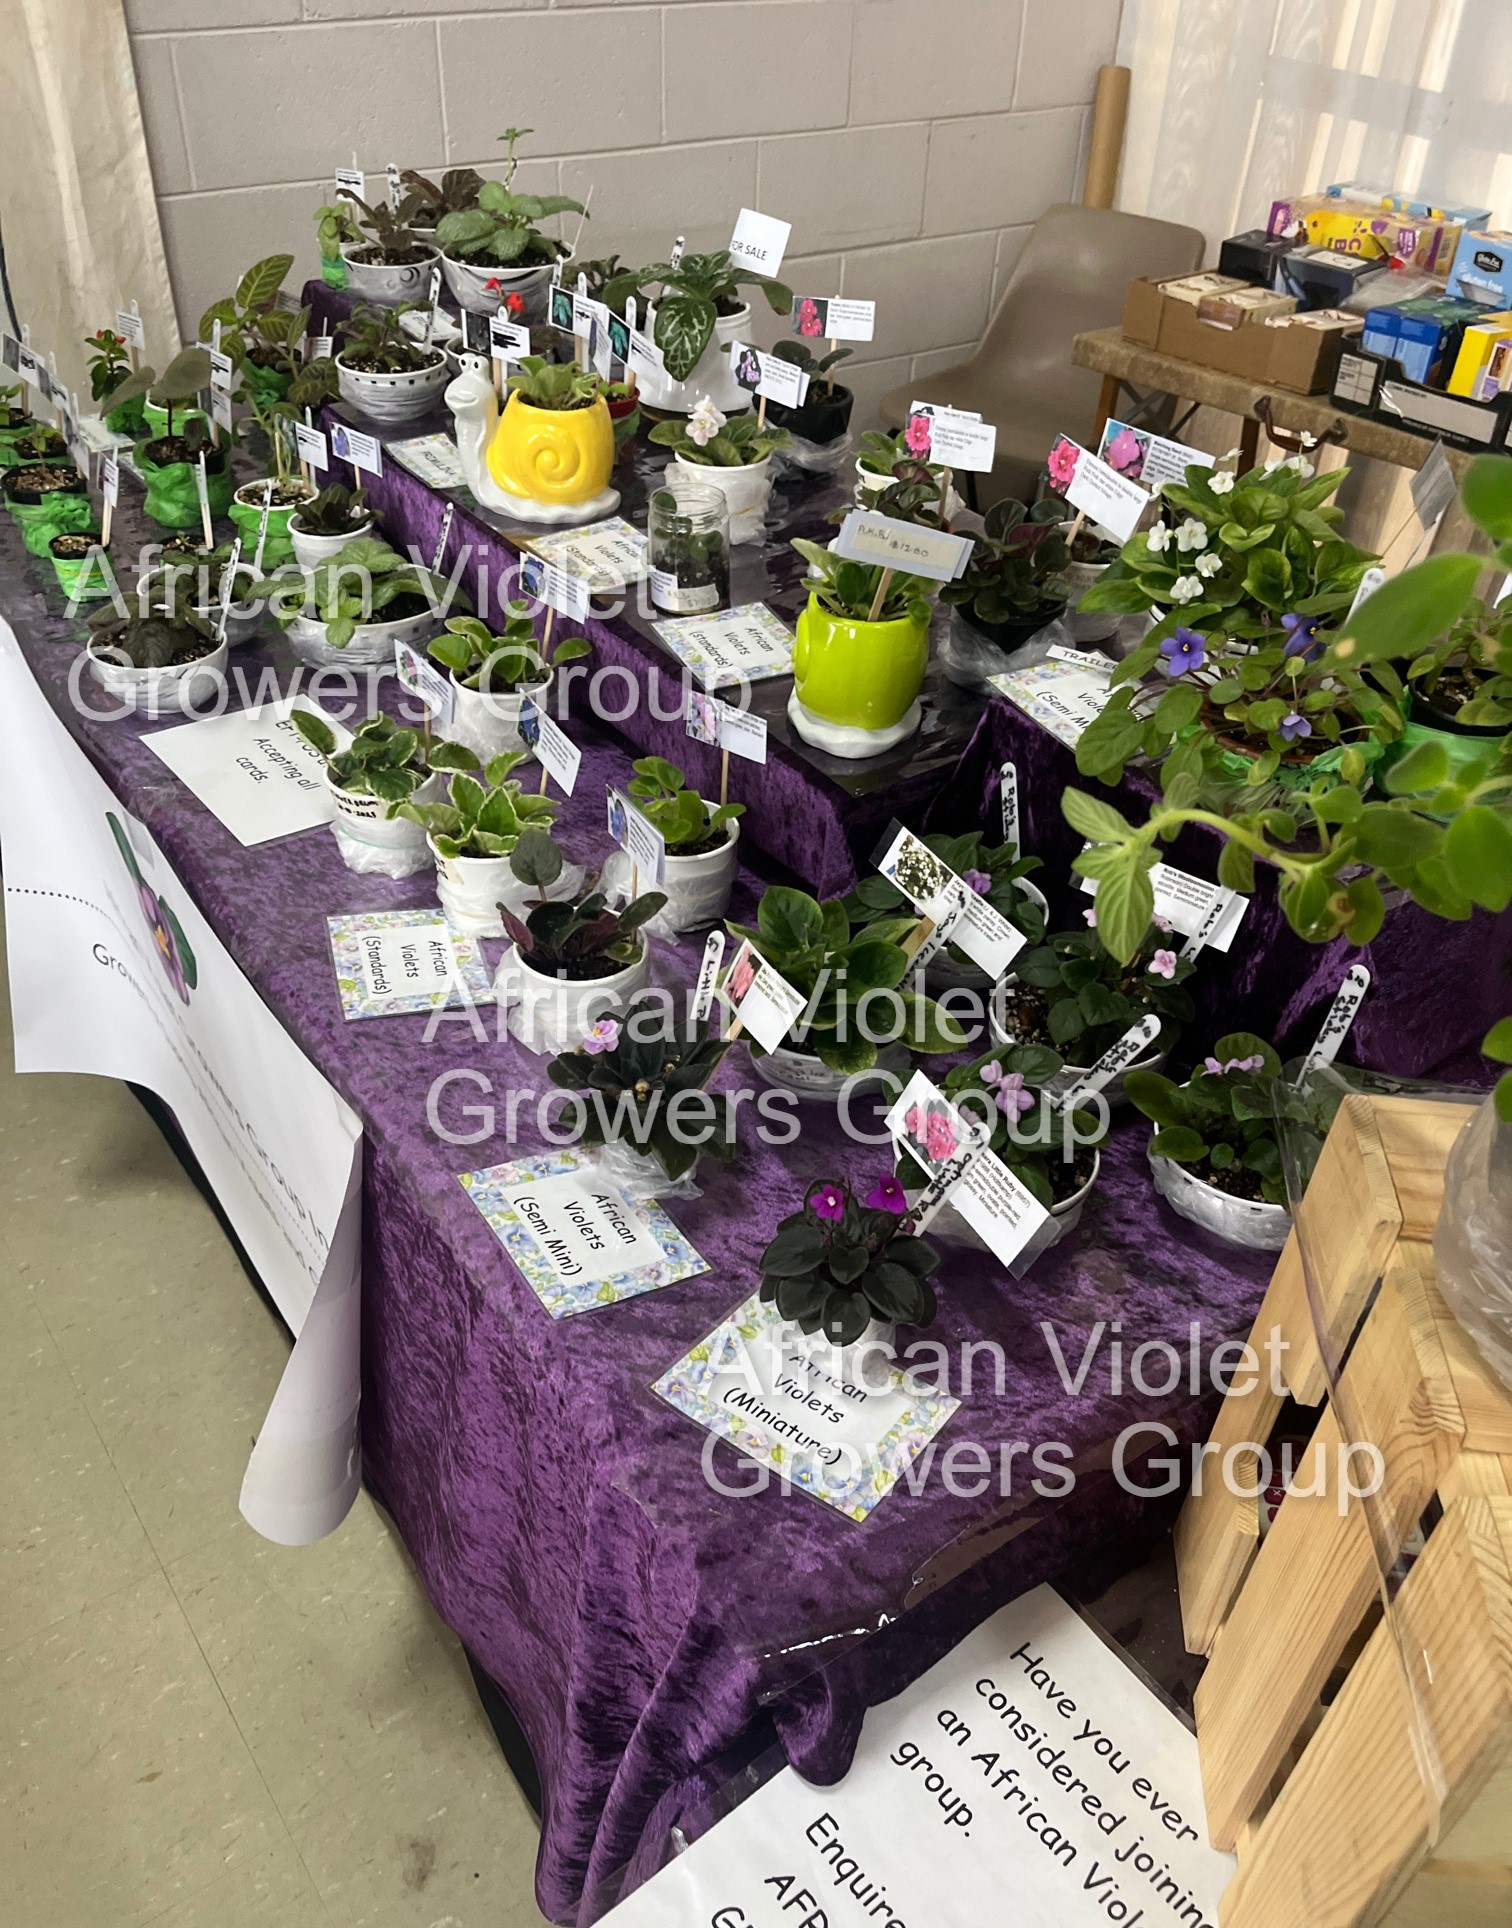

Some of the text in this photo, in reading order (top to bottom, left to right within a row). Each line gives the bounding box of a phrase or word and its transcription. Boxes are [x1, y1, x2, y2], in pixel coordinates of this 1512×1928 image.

[744, 244, 767, 261] SALE
[594, 543, 624, 565] Violets
[723, 631, 751, 656] Violets
[745, 627, 774, 653] African
[1036, 691, 1074, 717] (Semi
[235, 756, 269, 784] cards.
[253, 738, 322, 791] Accepting all
[1197, 902, 1224, 940] Rob's
[361, 936, 393, 995] (Standards)
[400, 943, 420, 978] Violets
[427, 940, 448, 977] African
[990, 1163, 1004, 1177] Little
[1001, 1176, 1016, 1192] Ruby
[512, 1196, 584, 1277] (Semi Mini)
[563, 1200, 606, 1250] Violets
[590, 1193, 638, 1245] African
[773, 1373, 846, 1424] Violets
[722, 1387, 844, 1467] (Miniature)
[1009, 1641, 1199, 1841] Have you ever
[890, 1742, 973, 1838] group.
[975, 1678, 1214, 1928] considered joinin
[936, 1709, 1144, 1928] an African Viol
[764, 1875, 829, 1928] AFR
